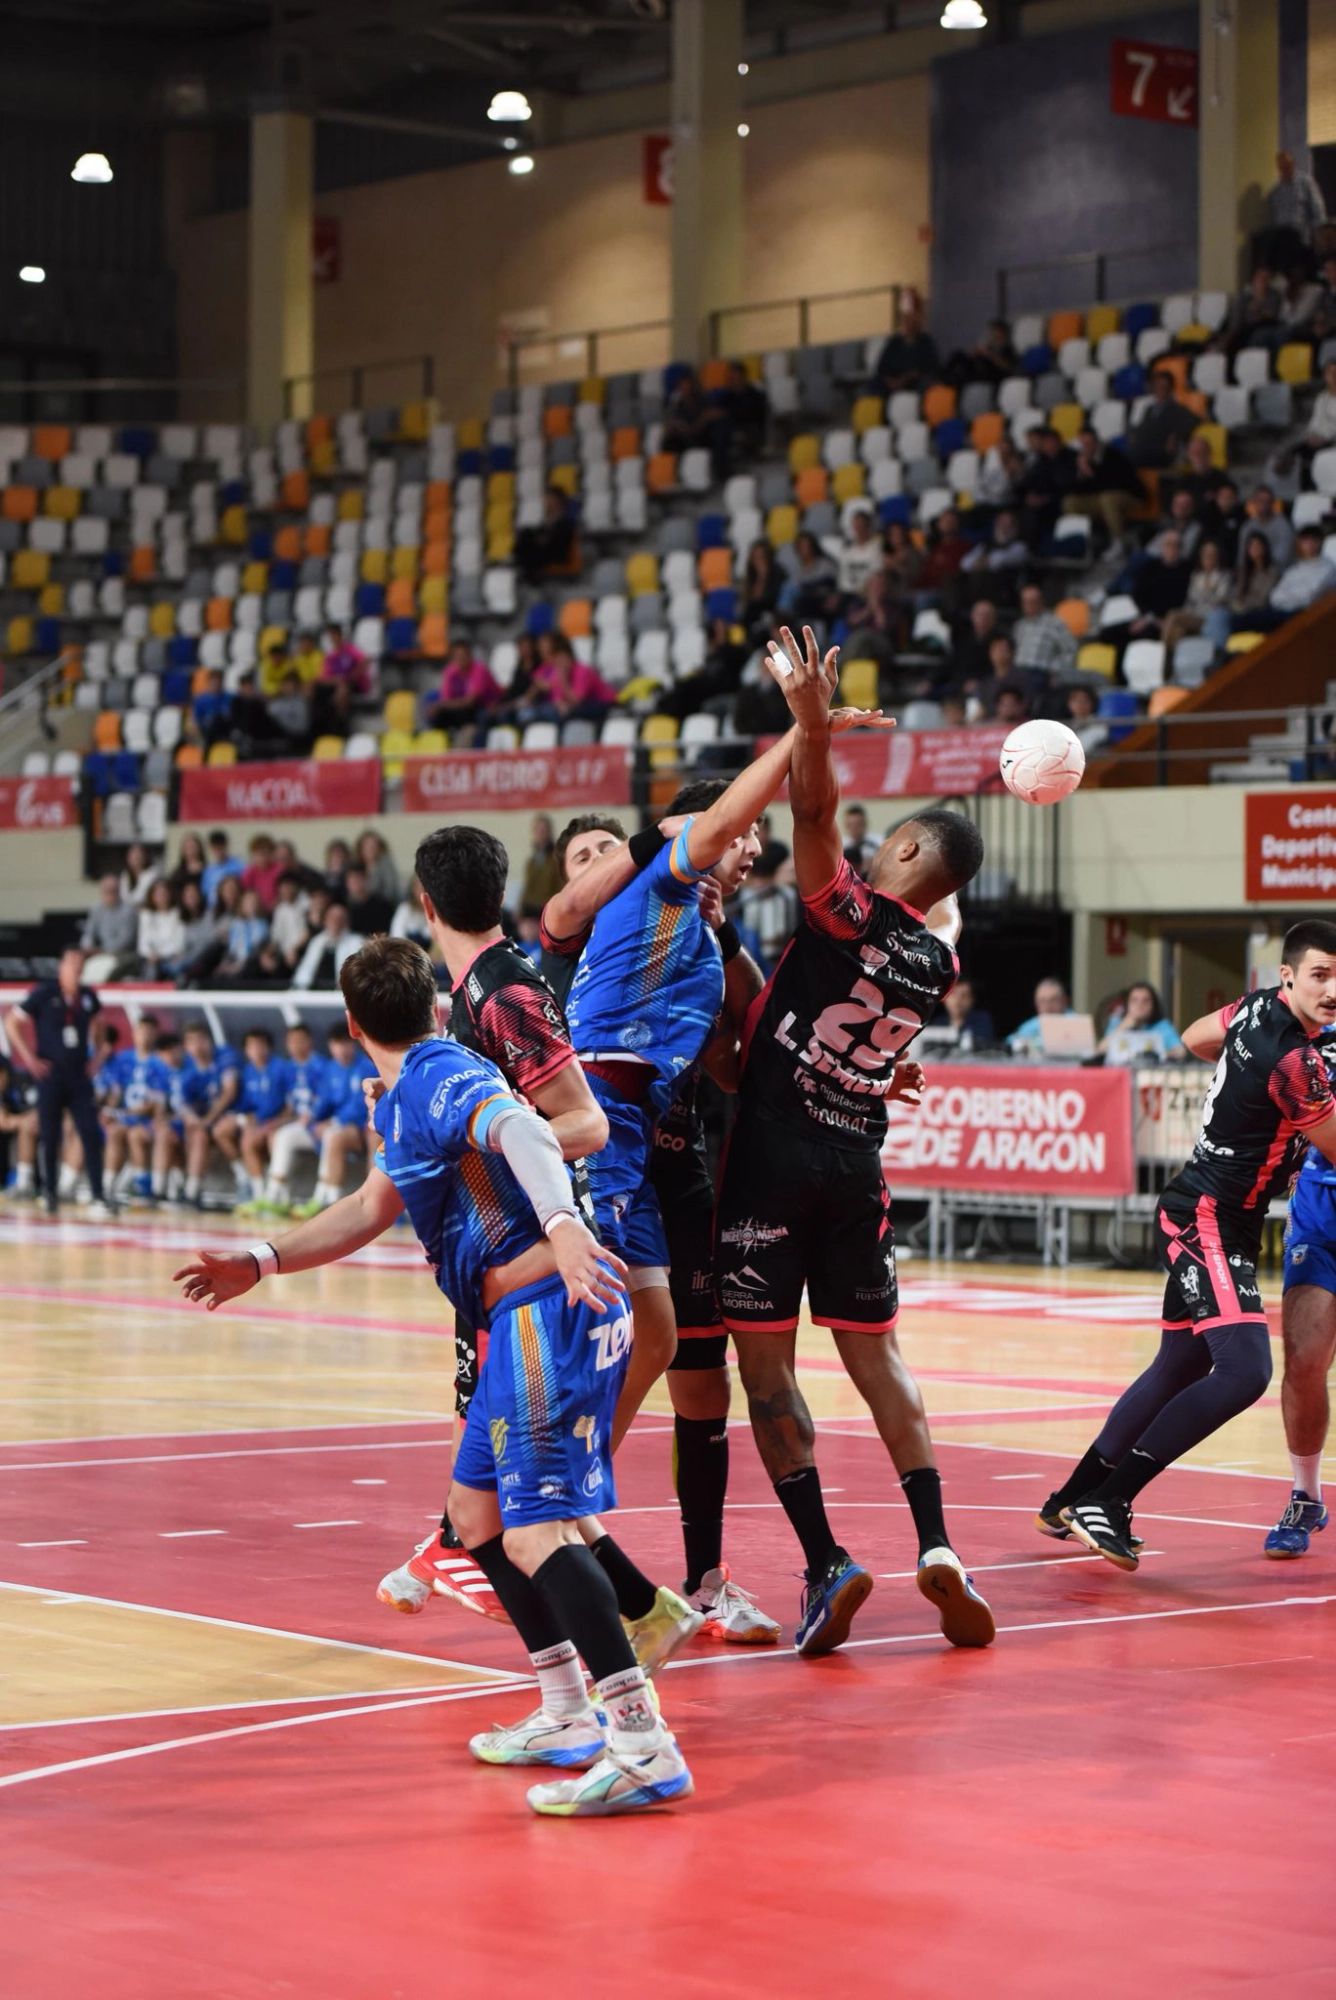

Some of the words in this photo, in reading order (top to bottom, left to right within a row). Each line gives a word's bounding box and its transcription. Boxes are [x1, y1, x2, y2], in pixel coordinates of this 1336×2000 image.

[1126, 51, 1156, 105] 7
[812, 977, 923, 1070] 29
[921, 1085, 1087, 1131] GOBIERNO
[917, 1128, 963, 1168] DE
[722, 1298, 774, 1310] MORENA
